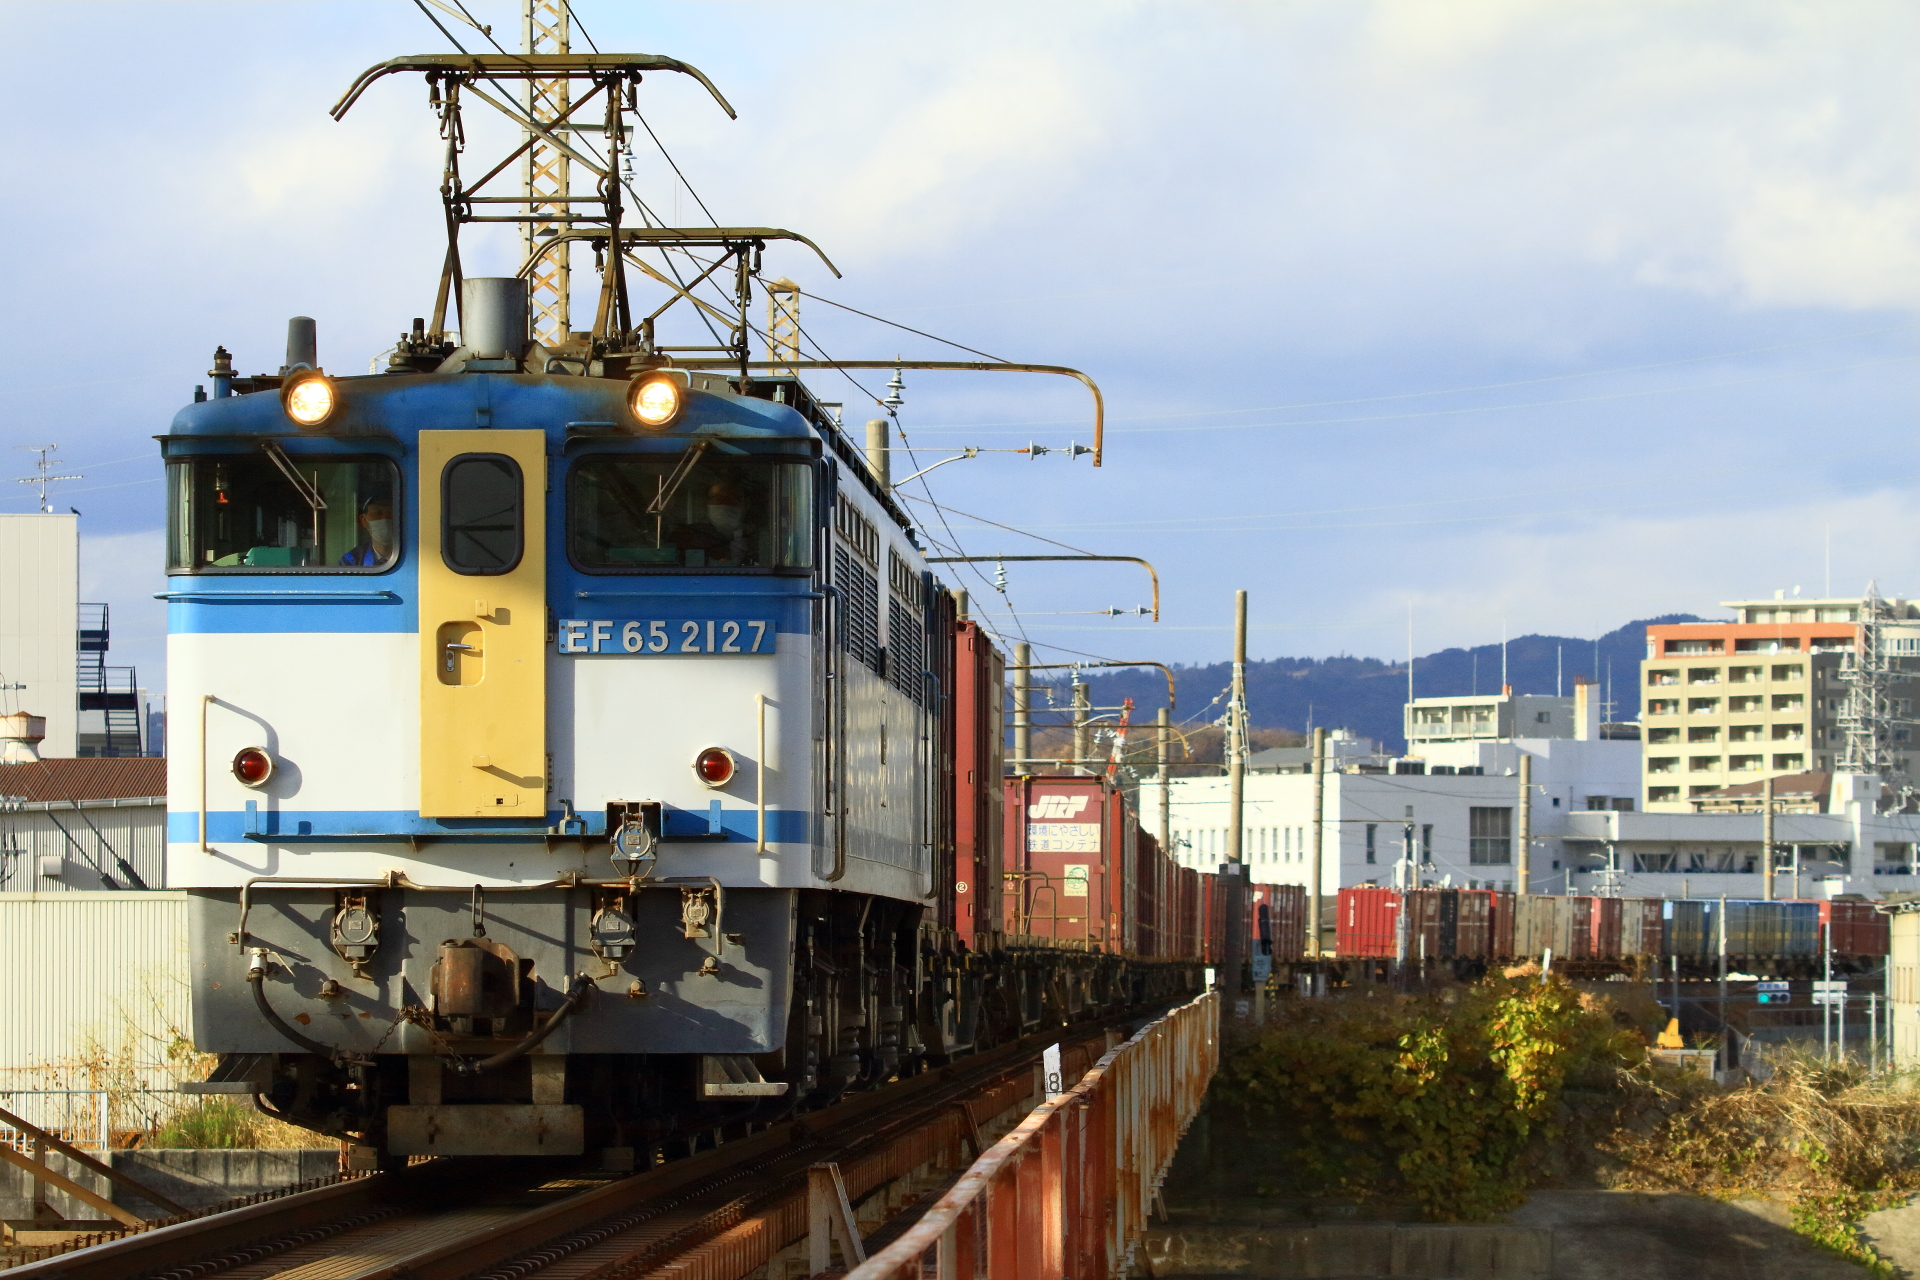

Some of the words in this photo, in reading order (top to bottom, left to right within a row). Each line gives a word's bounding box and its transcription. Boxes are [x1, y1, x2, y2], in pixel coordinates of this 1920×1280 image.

[681, 621, 766, 652] 2127
[1028, 795, 1089, 818] JRF
[1027, 825, 1099, 836] 環境にやさしい
[1027, 839, 1099, 851] 鉄道コンテナ
[1049, 1073, 1059, 1092] 8
